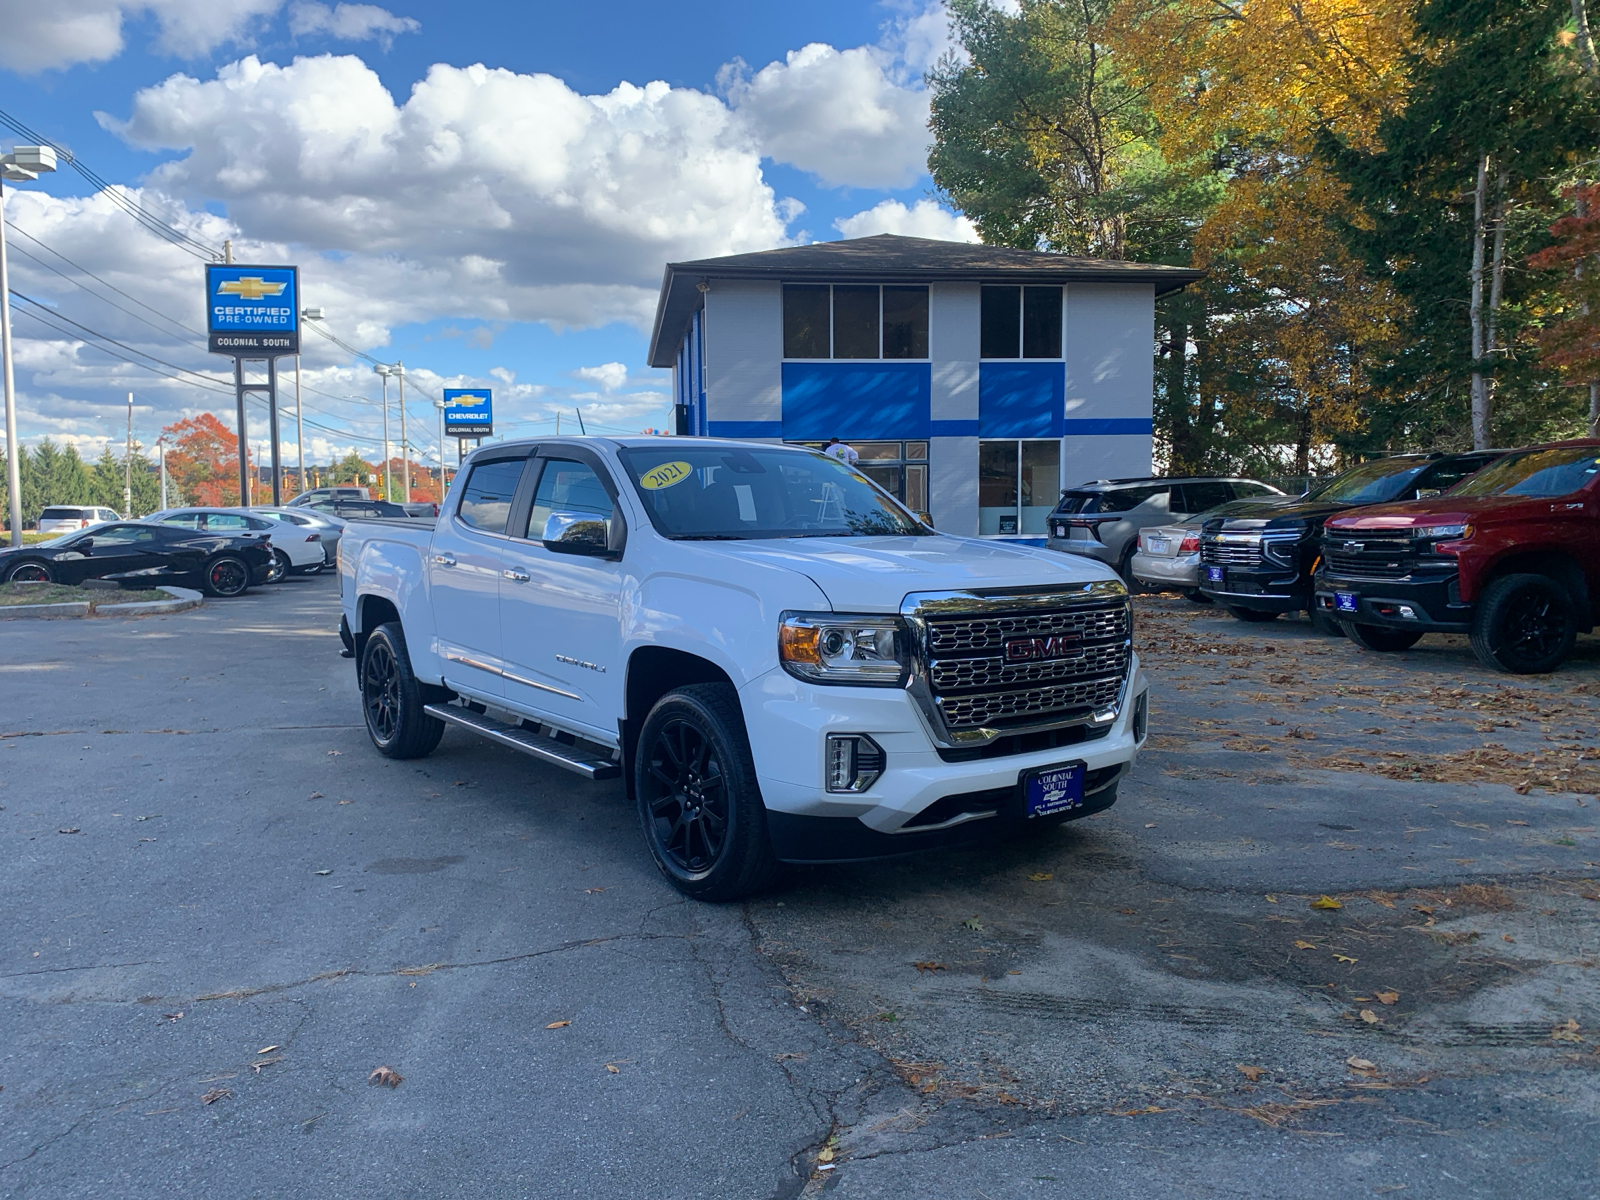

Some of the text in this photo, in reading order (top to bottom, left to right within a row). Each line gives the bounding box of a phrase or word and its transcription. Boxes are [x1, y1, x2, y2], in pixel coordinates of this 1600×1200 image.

[214, 306, 291, 316] CERTIFIED
[218, 315, 288, 324] PRE-OWNED
[217, 337, 290, 347] COLONIAL SOUTH
[649, 463, 684, 487] 2021
[1006, 634, 1082, 661] GMC
[556, 654, 606, 673] DENALI
[1038, 772, 1073, 785] COLONIAL
[1043, 781, 1067, 792] SOUTH
